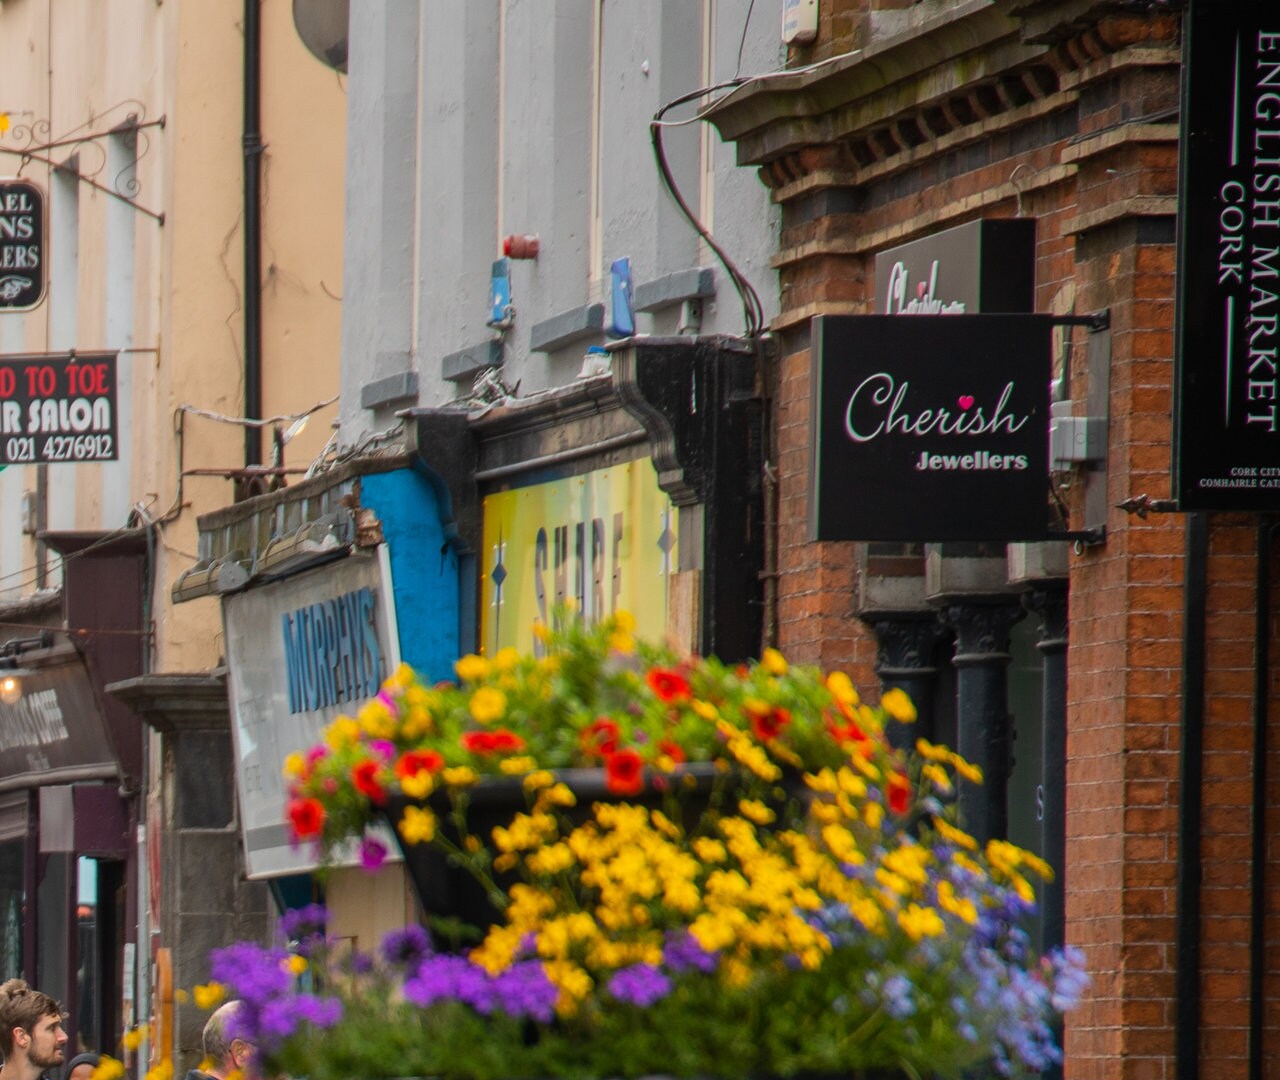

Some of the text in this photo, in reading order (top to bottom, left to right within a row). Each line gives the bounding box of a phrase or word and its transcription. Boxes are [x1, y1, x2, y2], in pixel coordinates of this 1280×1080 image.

[1219, 180, 1245, 285] CORK
[1246, 29, 1280, 433] ENGLISH MARKET
[25, 366, 57, 397] TO
[64, 363, 110, 396] TOE
[28, 397, 111, 434] SALON
[845, 372, 1030, 442] Cherish
[6, 438, 36, 461] 021
[43, 434, 113, 460] 4276912
[915, 451, 1030, 470] Jewellers
[1200, 479, 1257, 488] COMHAIRLE
[1231, 467, 1257, 476] CORK
